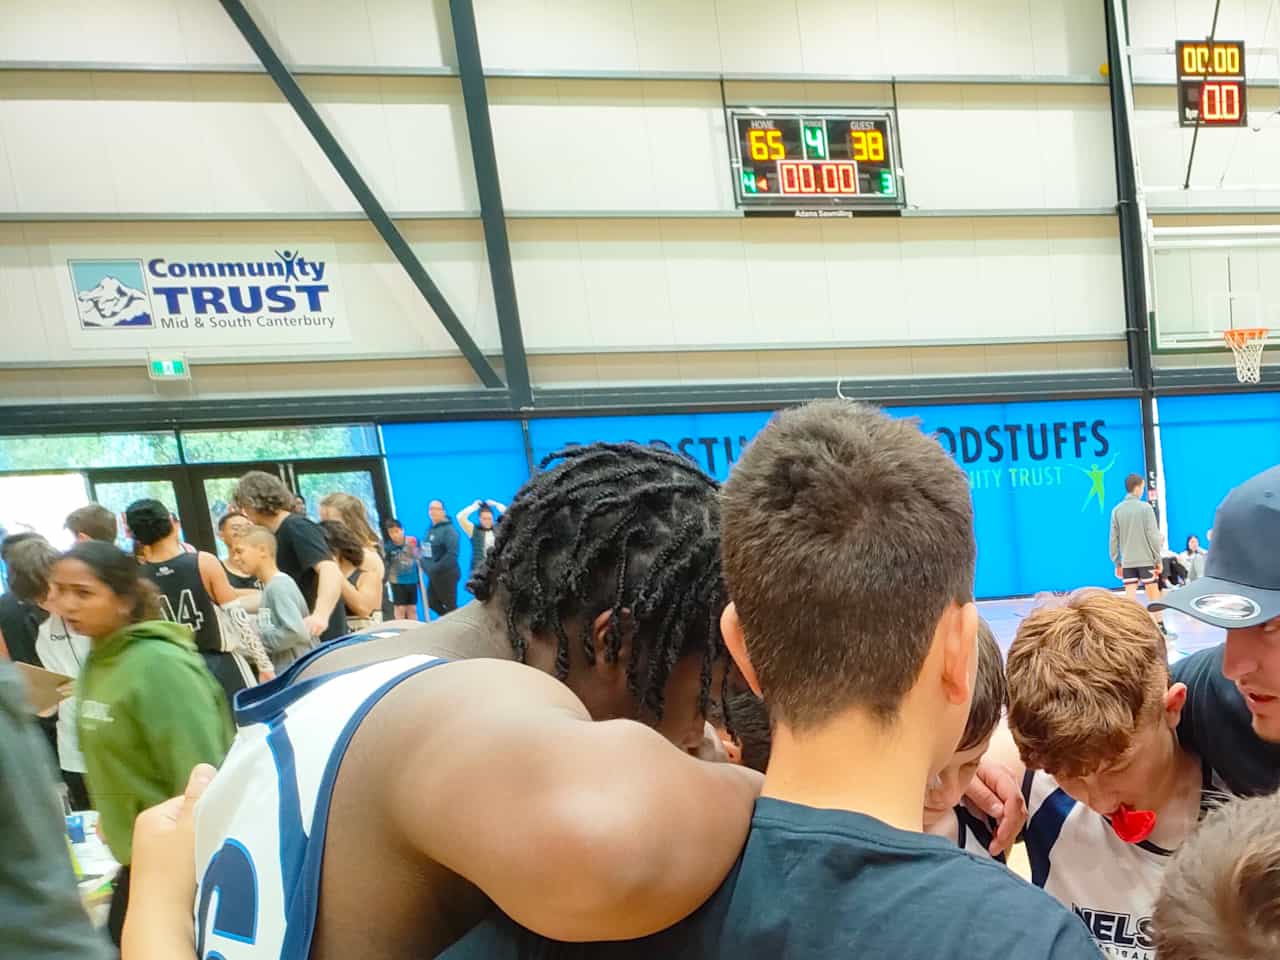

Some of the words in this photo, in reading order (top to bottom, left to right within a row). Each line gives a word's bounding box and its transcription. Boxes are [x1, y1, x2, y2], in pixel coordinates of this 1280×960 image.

[1203, 85, 1240, 120] 00
[750, 130, 785, 160] 65
[804, 128, 825, 157] 4
[850, 131, 885, 161] 38
[781, 164, 856, 193] 00.00
[149, 249, 325, 283] Community
[153, 285, 329, 314] TRUST
[161, 316, 189, 329] Mid
[195, 317, 204, 328] &
[209, 315, 252, 329] South
[256, 314, 335, 329] Canterbury
[1009, 466, 1062, 487] TRUST
